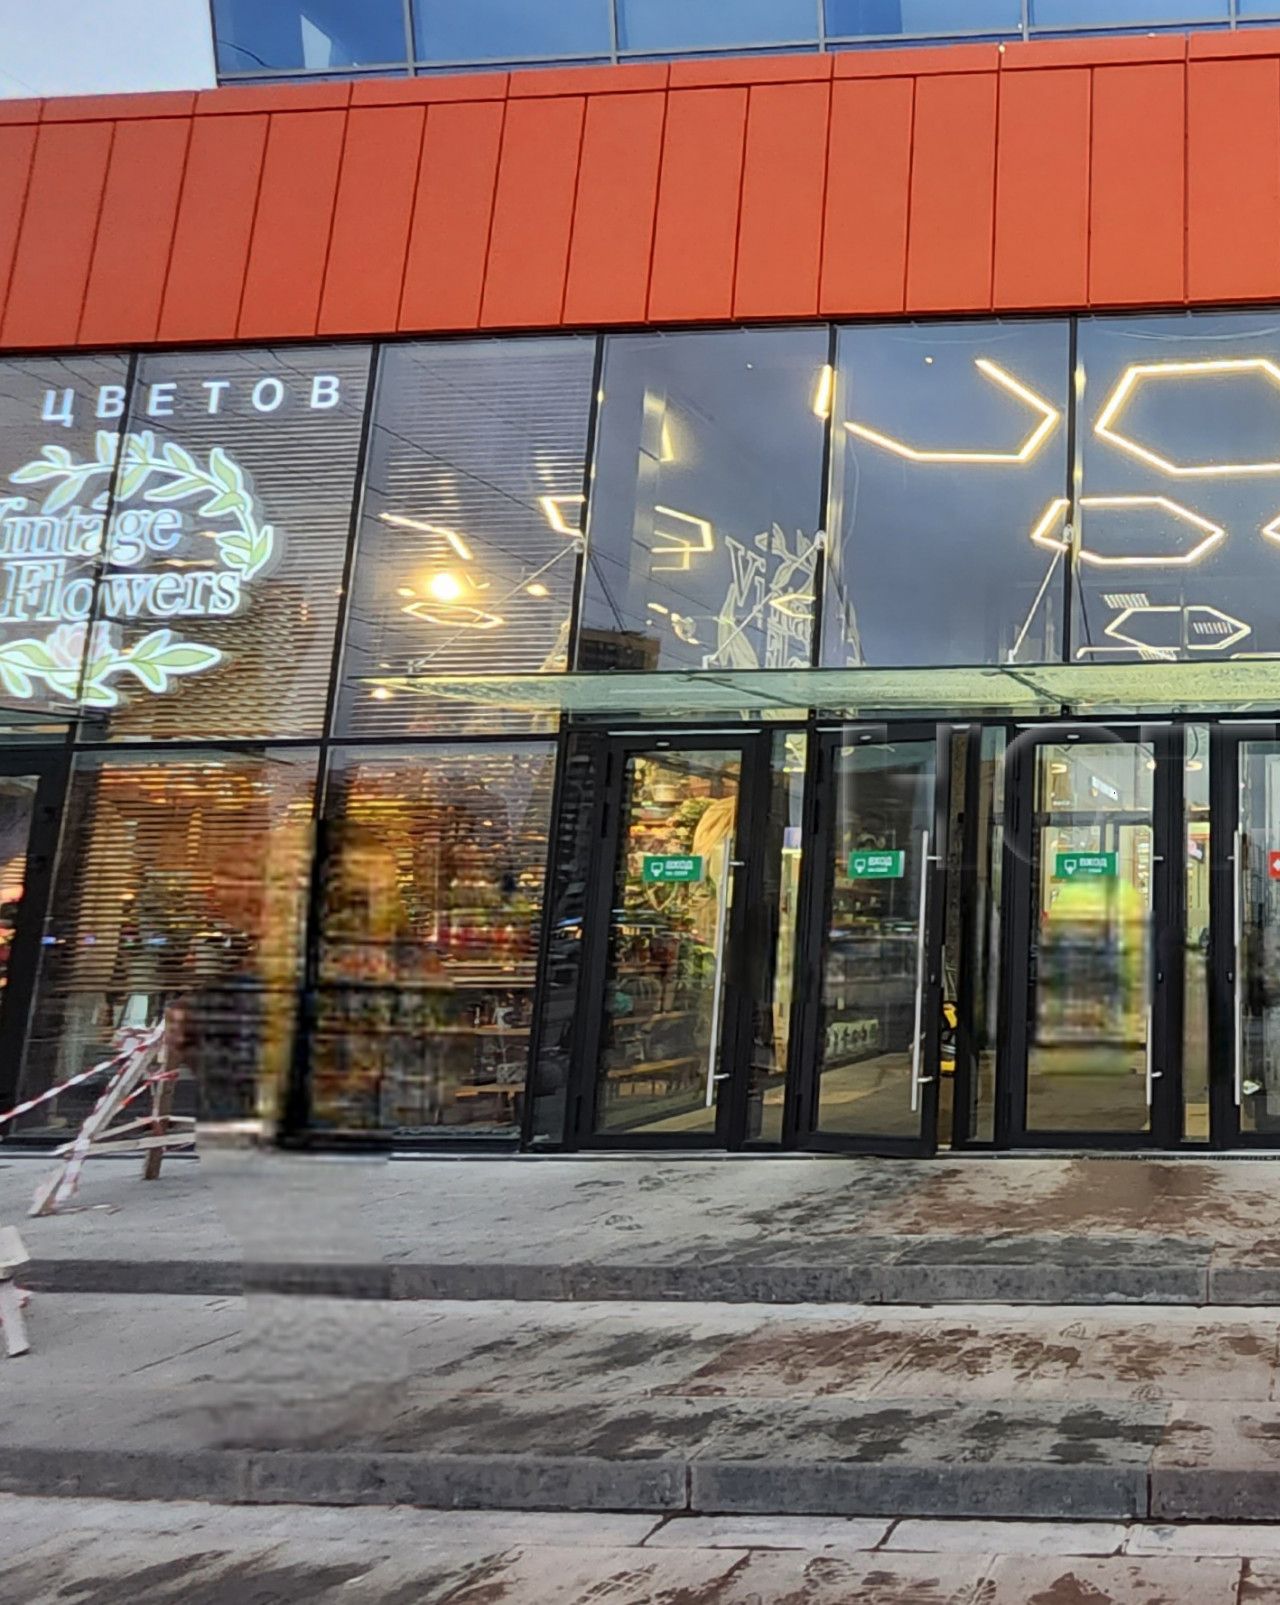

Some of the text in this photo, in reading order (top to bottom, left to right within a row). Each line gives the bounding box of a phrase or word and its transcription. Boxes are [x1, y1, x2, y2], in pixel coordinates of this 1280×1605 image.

[41, 374, 341, 428] ЦВЕТОВ
[0, 495, 183, 566] intage
[0, 558, 241, 622] Flowers
